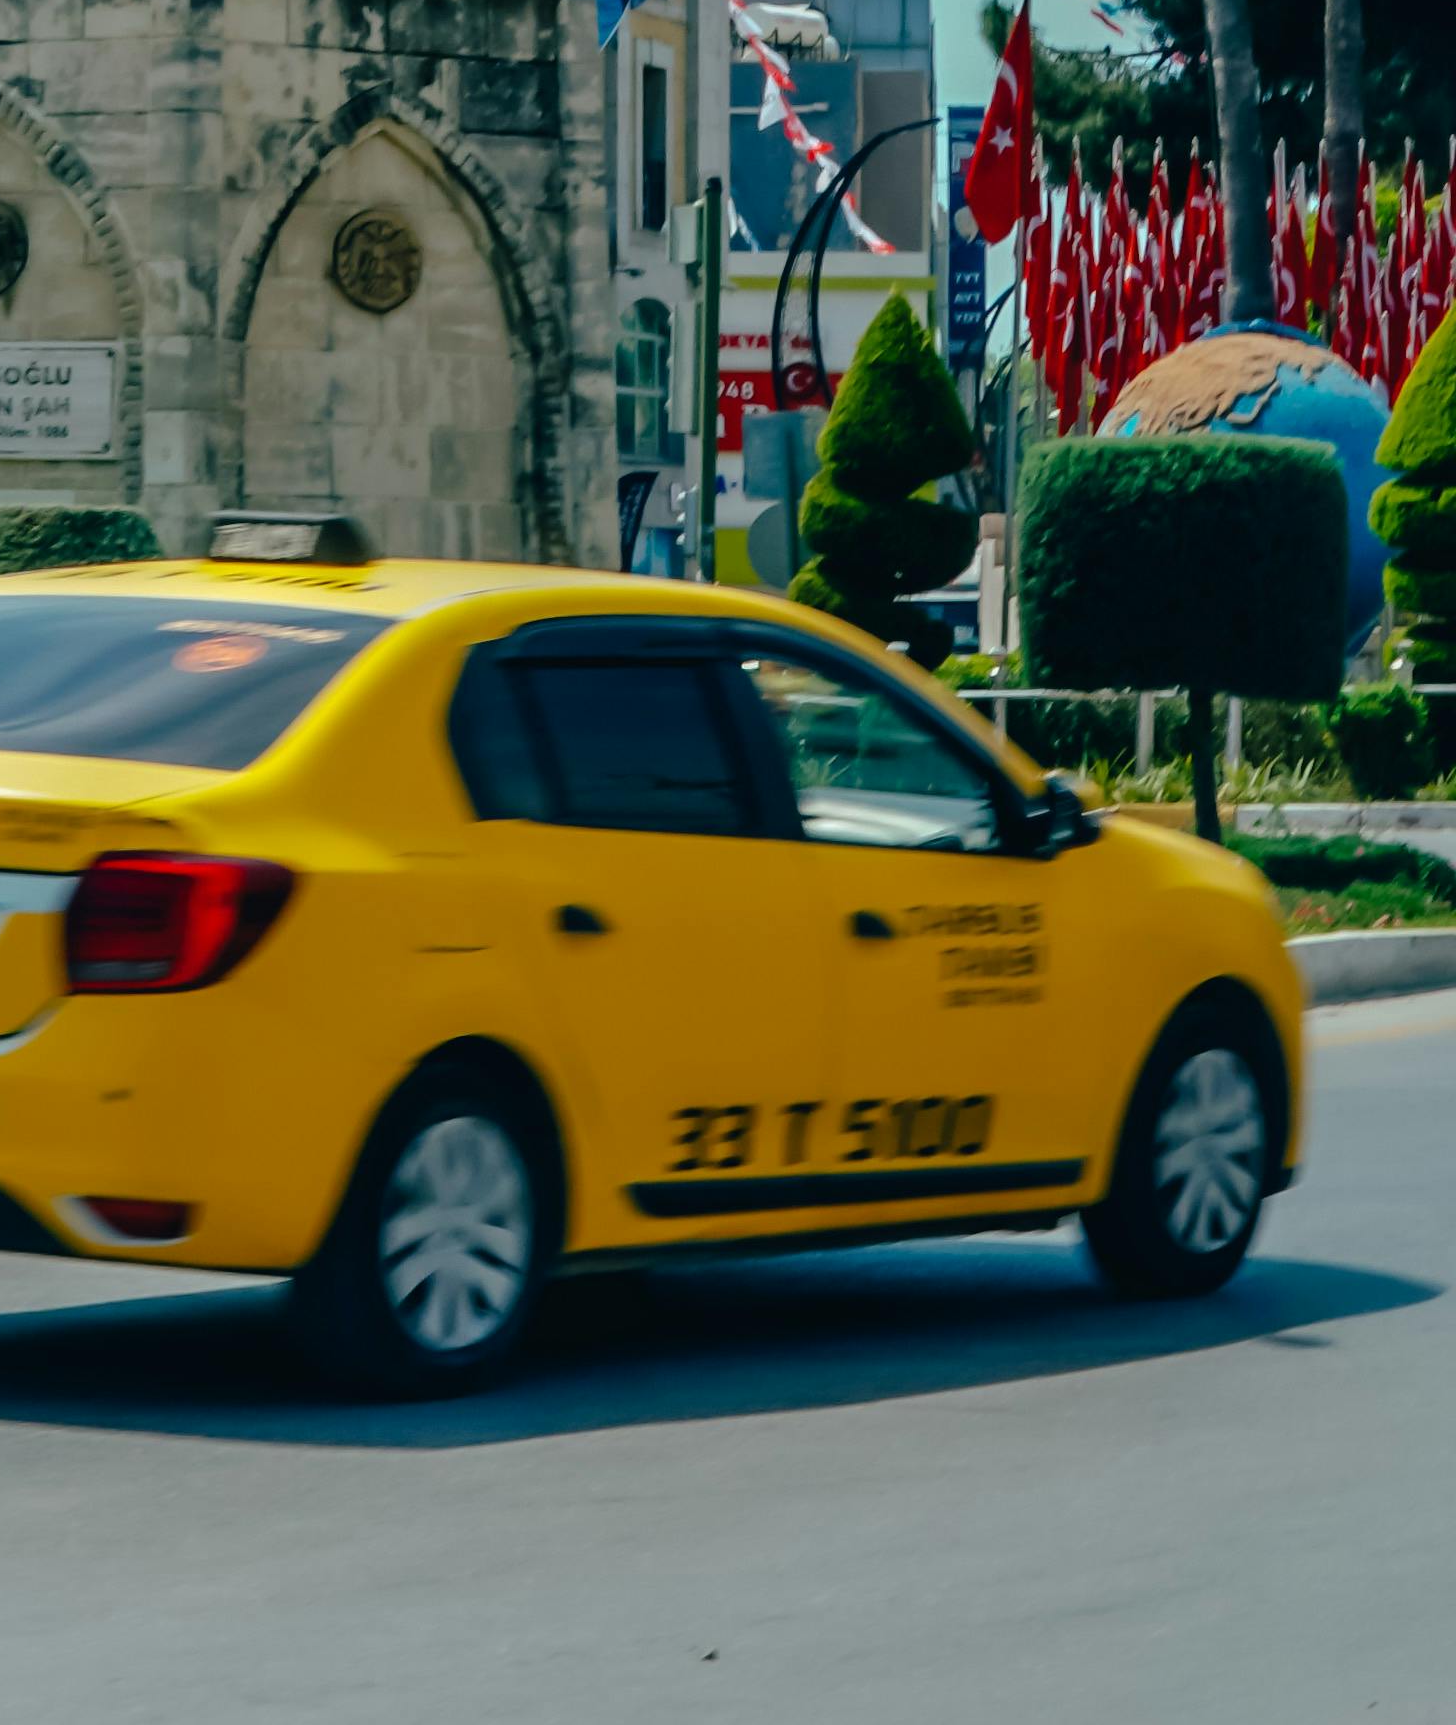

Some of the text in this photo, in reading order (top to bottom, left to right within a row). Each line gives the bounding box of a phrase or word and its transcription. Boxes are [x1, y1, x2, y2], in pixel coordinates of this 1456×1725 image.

[669, 1094, 996, 1172] 33 T 5100
